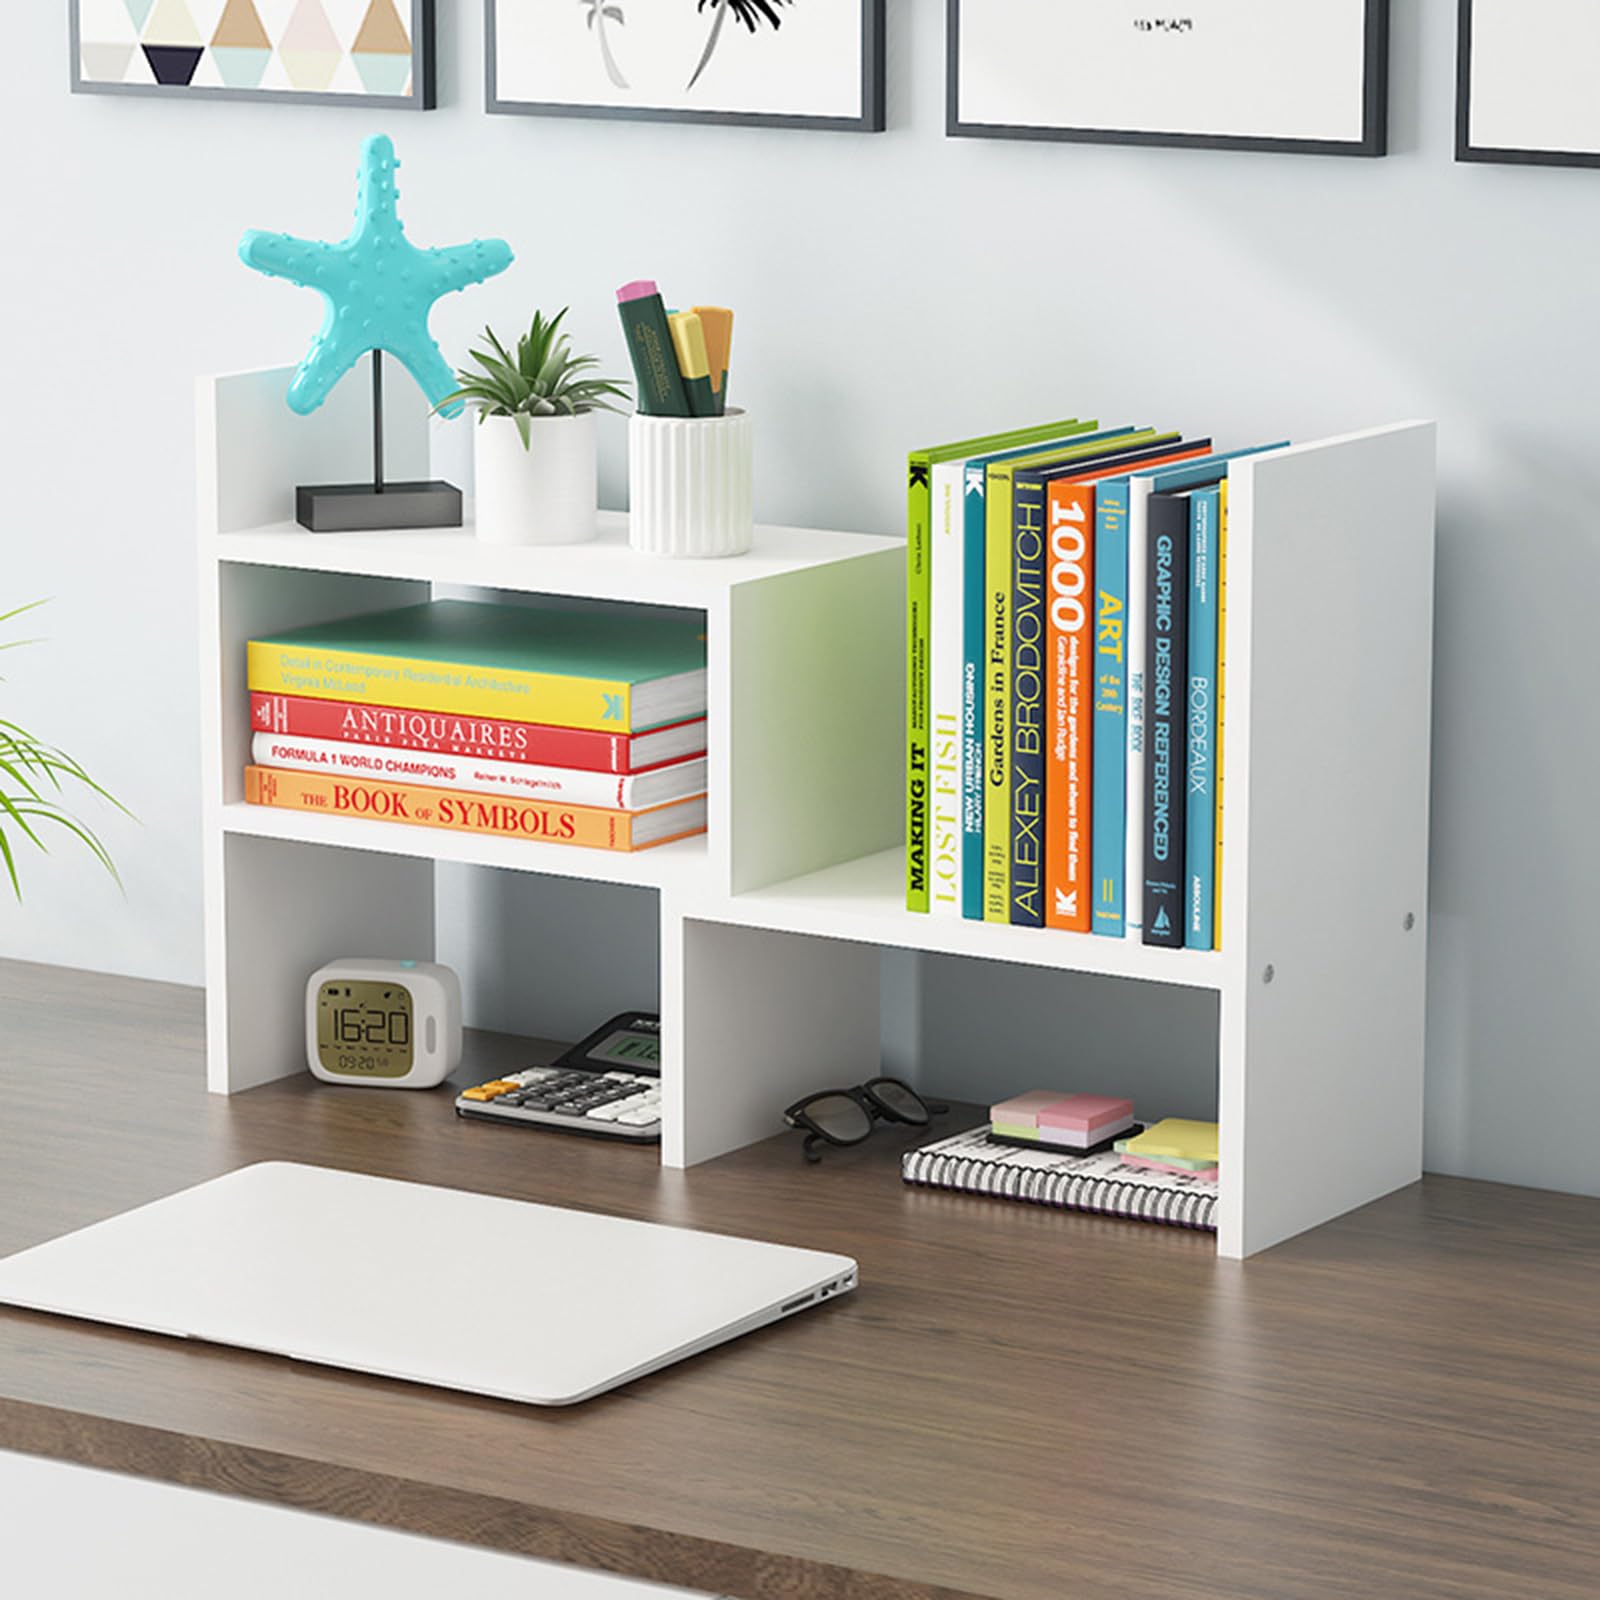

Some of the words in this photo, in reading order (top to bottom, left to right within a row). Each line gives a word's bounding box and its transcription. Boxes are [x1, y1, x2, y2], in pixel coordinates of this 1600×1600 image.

[1050, 499, 1086, 633] 1000
[1155, 535, 1173, 632] GRAPHIC
[991, 591, 1006, 665] France
[1014, 502, 1043, 755] BRODOVITCH
[1098, 589, 1123, 664] ART
[964, 662, 975, 736] HOUSING
[991, 671, 1005, 692] in
[1154, 637, 1172, 717] DESIGN
[271, 745, 329, 765] FORMULA
[330, 753, 337, 765] 1
[339, 754, 384, 771] WORLD
[385, 759, 457, 780] CHAMPIONS
[341, 707, 528, 750] ANTIQUAIRES
[911, 742, 925, 772] IT
[935, 713, 957, 795] FISH
[964, 738, 975, 793] URBAN
[990, 698, 1005, 788] Gardens
[1189, 676, 1209, 795] BORDEAUX
[301, 792, 329, 807] THE
[333, 784, 409, 819] BOOK
[415, 806, 433, 821] OF
[438, 797, 576, 840] SYMBOLS
[964, 795, 975, 834] NEW
[1153, 722, 1171, 861] REFERENCED
[911, 779, 925, 892] MAKING
[935, 805, 957, 903] LOST
[1014, 765, 1040, 918] ALEXEY
